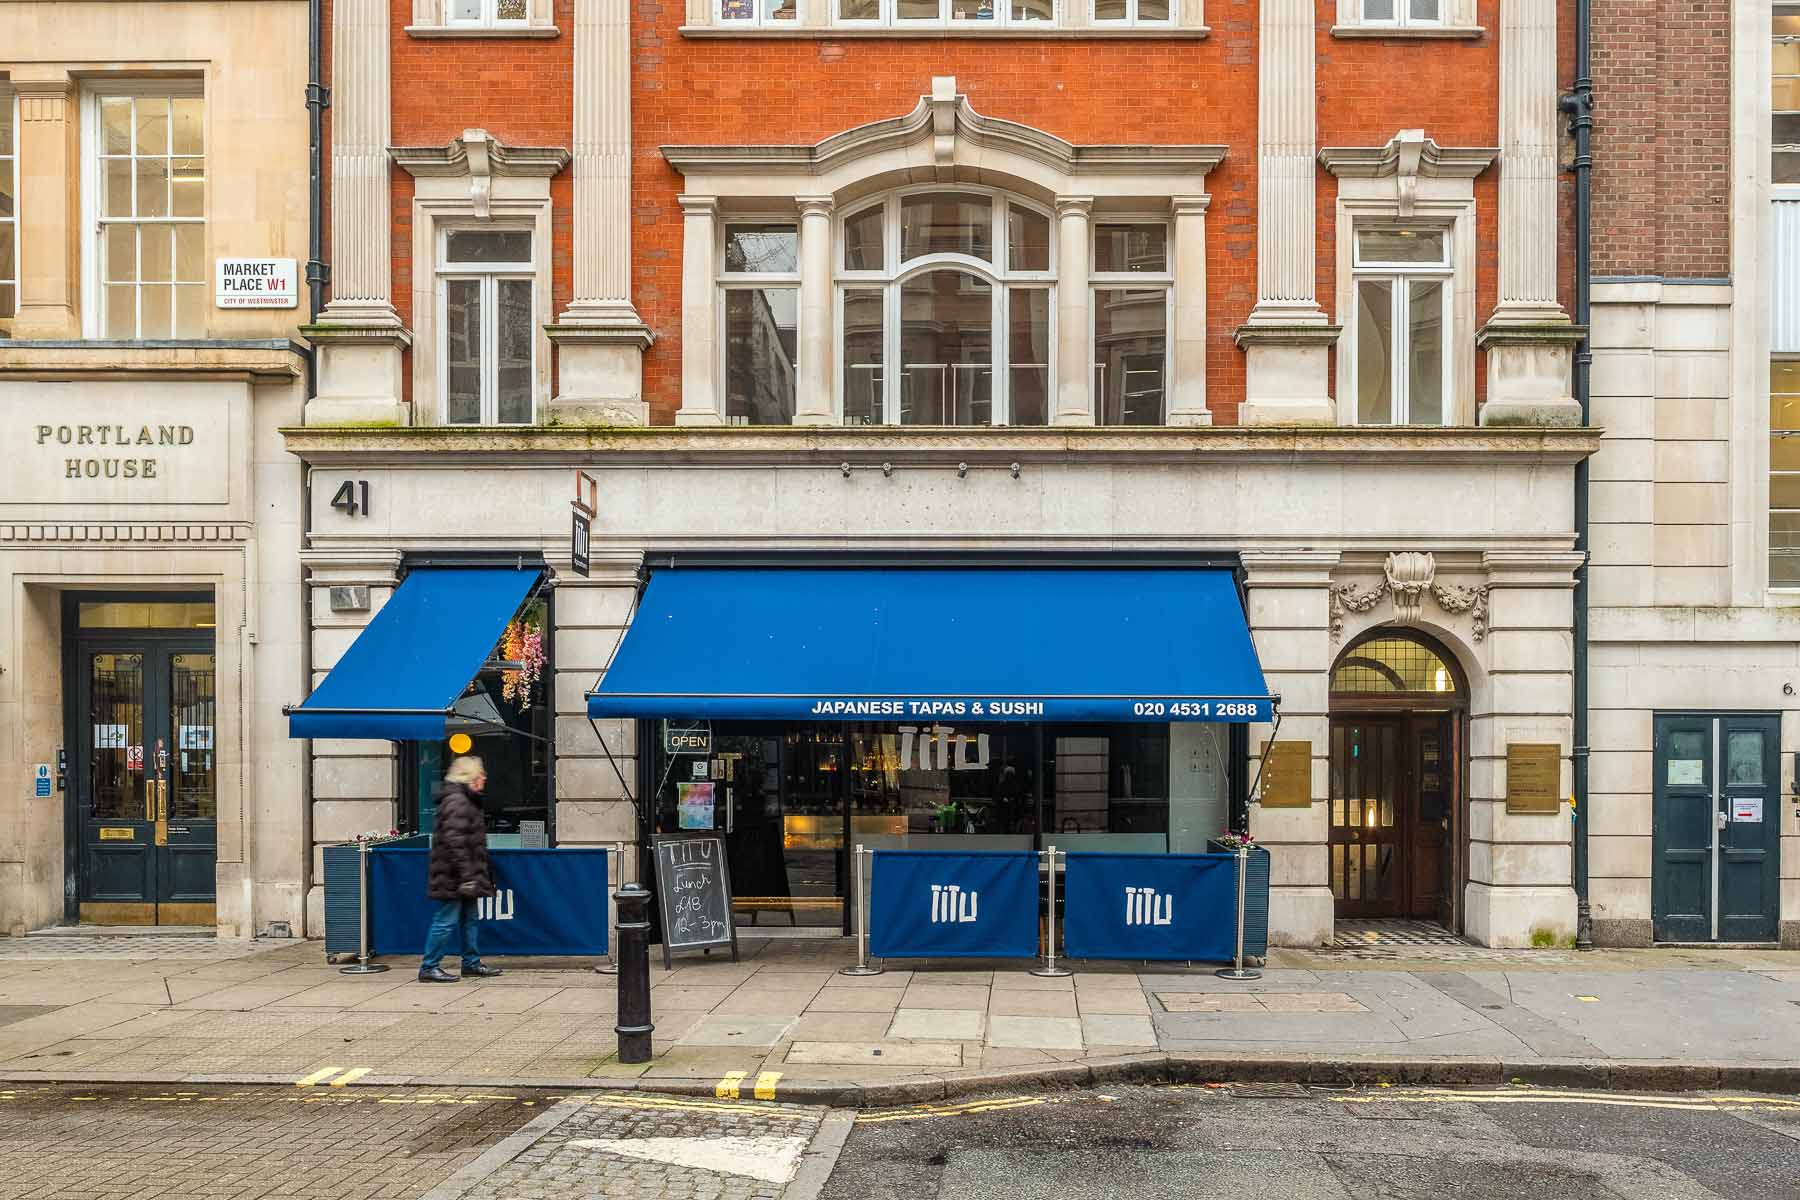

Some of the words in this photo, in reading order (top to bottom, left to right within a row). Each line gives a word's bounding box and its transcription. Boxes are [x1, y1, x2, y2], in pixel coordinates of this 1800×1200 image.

[223, 263, 276, 276] MARKET
[223, 278, 263, 291] PLACE
[267, 278, 286, 291] W1
[36, 424, 195, 446] PORTLAND
[65, 458, 157, 479] HOUSE
[330, 480, 369, 516] 41
[811, 701, 904, 715] JAPANESE
[909, 701, 966, 715] TAPAS
[971, 702, 985, 715] &
[989, 702, 1044, 715] SUSHI
[1134, 703, 1165, 716] 020
[1170, 703, 1209, 716] 4531
[1215, 703, 1257, 716] 2688
[671, 736, 707, 747] OPEN
